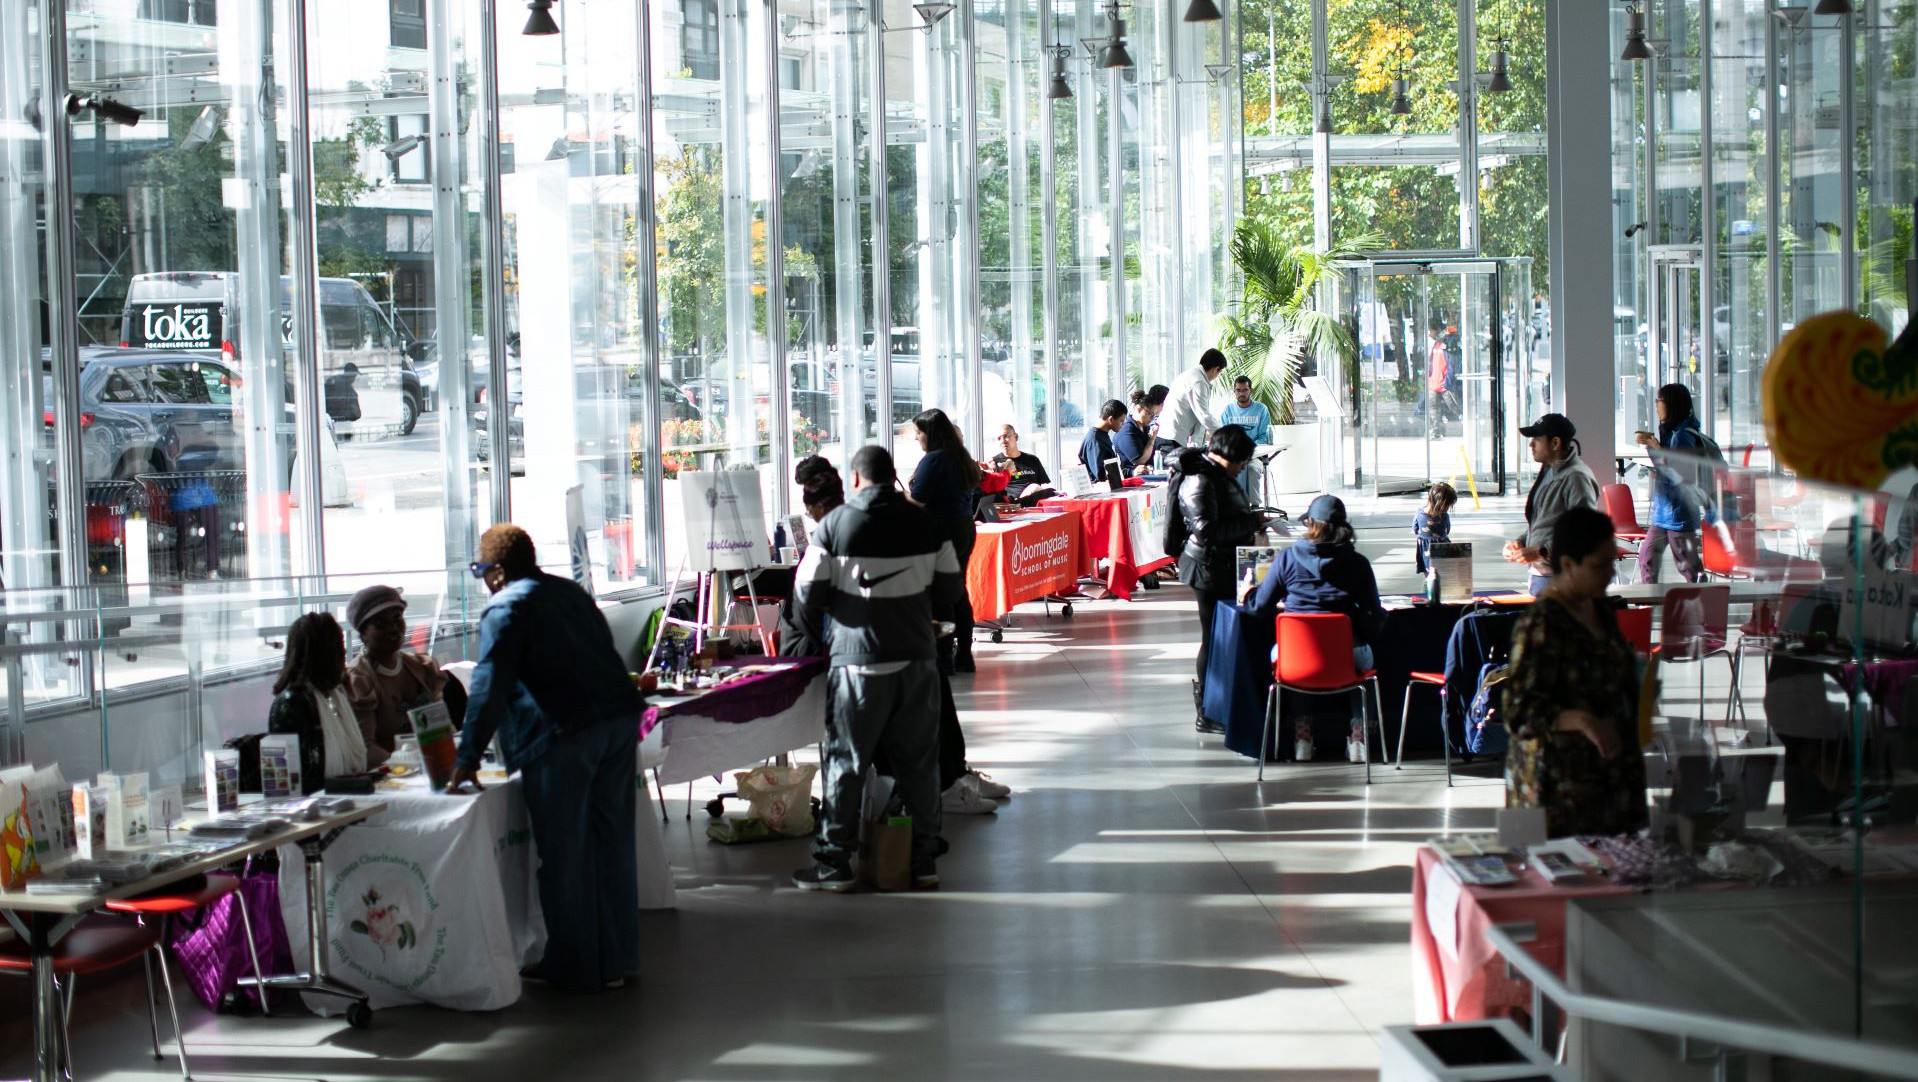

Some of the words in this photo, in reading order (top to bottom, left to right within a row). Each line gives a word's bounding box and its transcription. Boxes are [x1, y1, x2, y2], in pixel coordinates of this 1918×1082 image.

[143, 304, 211, 340] toka
[707, 539, 753, 552] Wellspace
[1012, 531, 1069, 575] Bloomingdale
[1021, 562, 1042, 577] SCHOOL
[1043, 559, 1051, 569] OF
[1052, 553, 1068, 567] MUSIC
